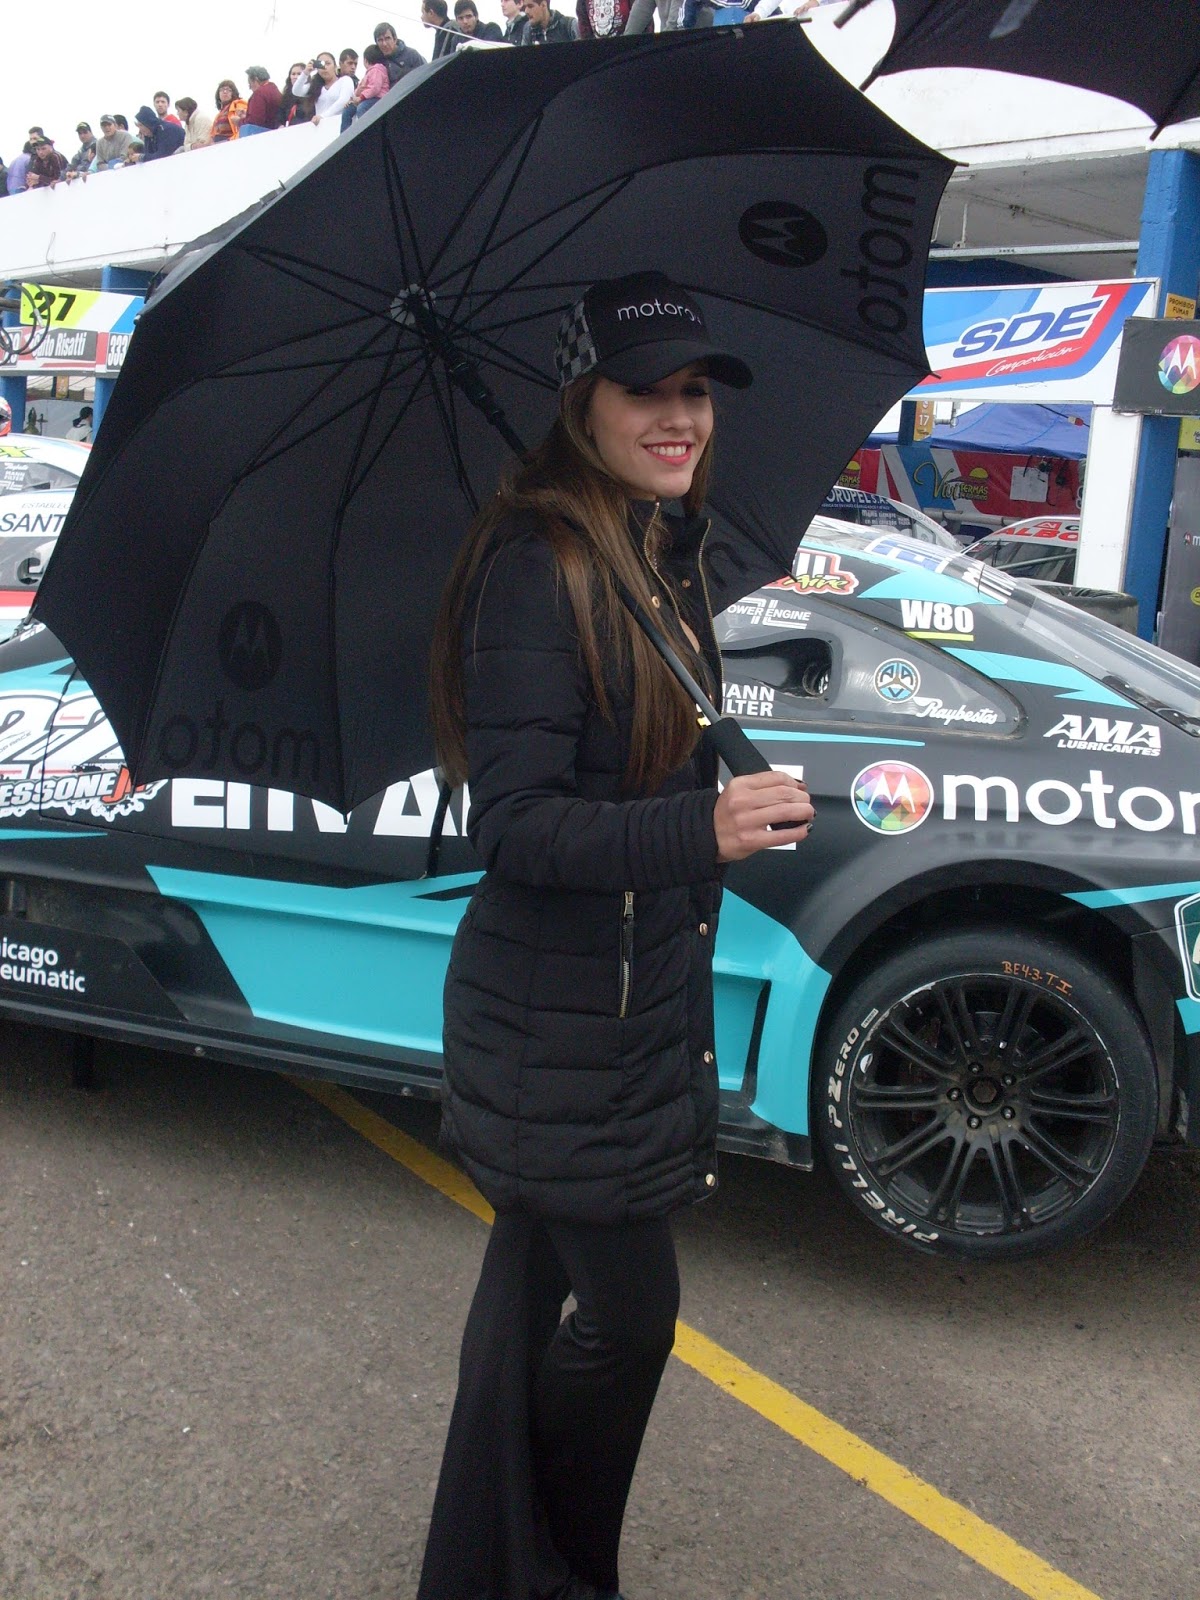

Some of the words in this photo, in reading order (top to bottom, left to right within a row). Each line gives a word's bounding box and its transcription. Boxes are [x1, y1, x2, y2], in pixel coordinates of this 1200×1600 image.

[28, 290, 77, 322] 27
[617, 298, 702, 326] motoro
[952, 299, 1104, 359] SDE
[919, 414, 930, 426] 17
[765, 608, 812, 621] ENGINE
[901, 599, 975, 633] W80
[912, 696, 999, 726] Raybestos
[1043, 714, 1161, 749] AMA
[1057, 739, 1161, 757] LUBRICANTES
[0, 937, 59, 967] icago
[833, 1143, 939, 1243] PIRELLI
